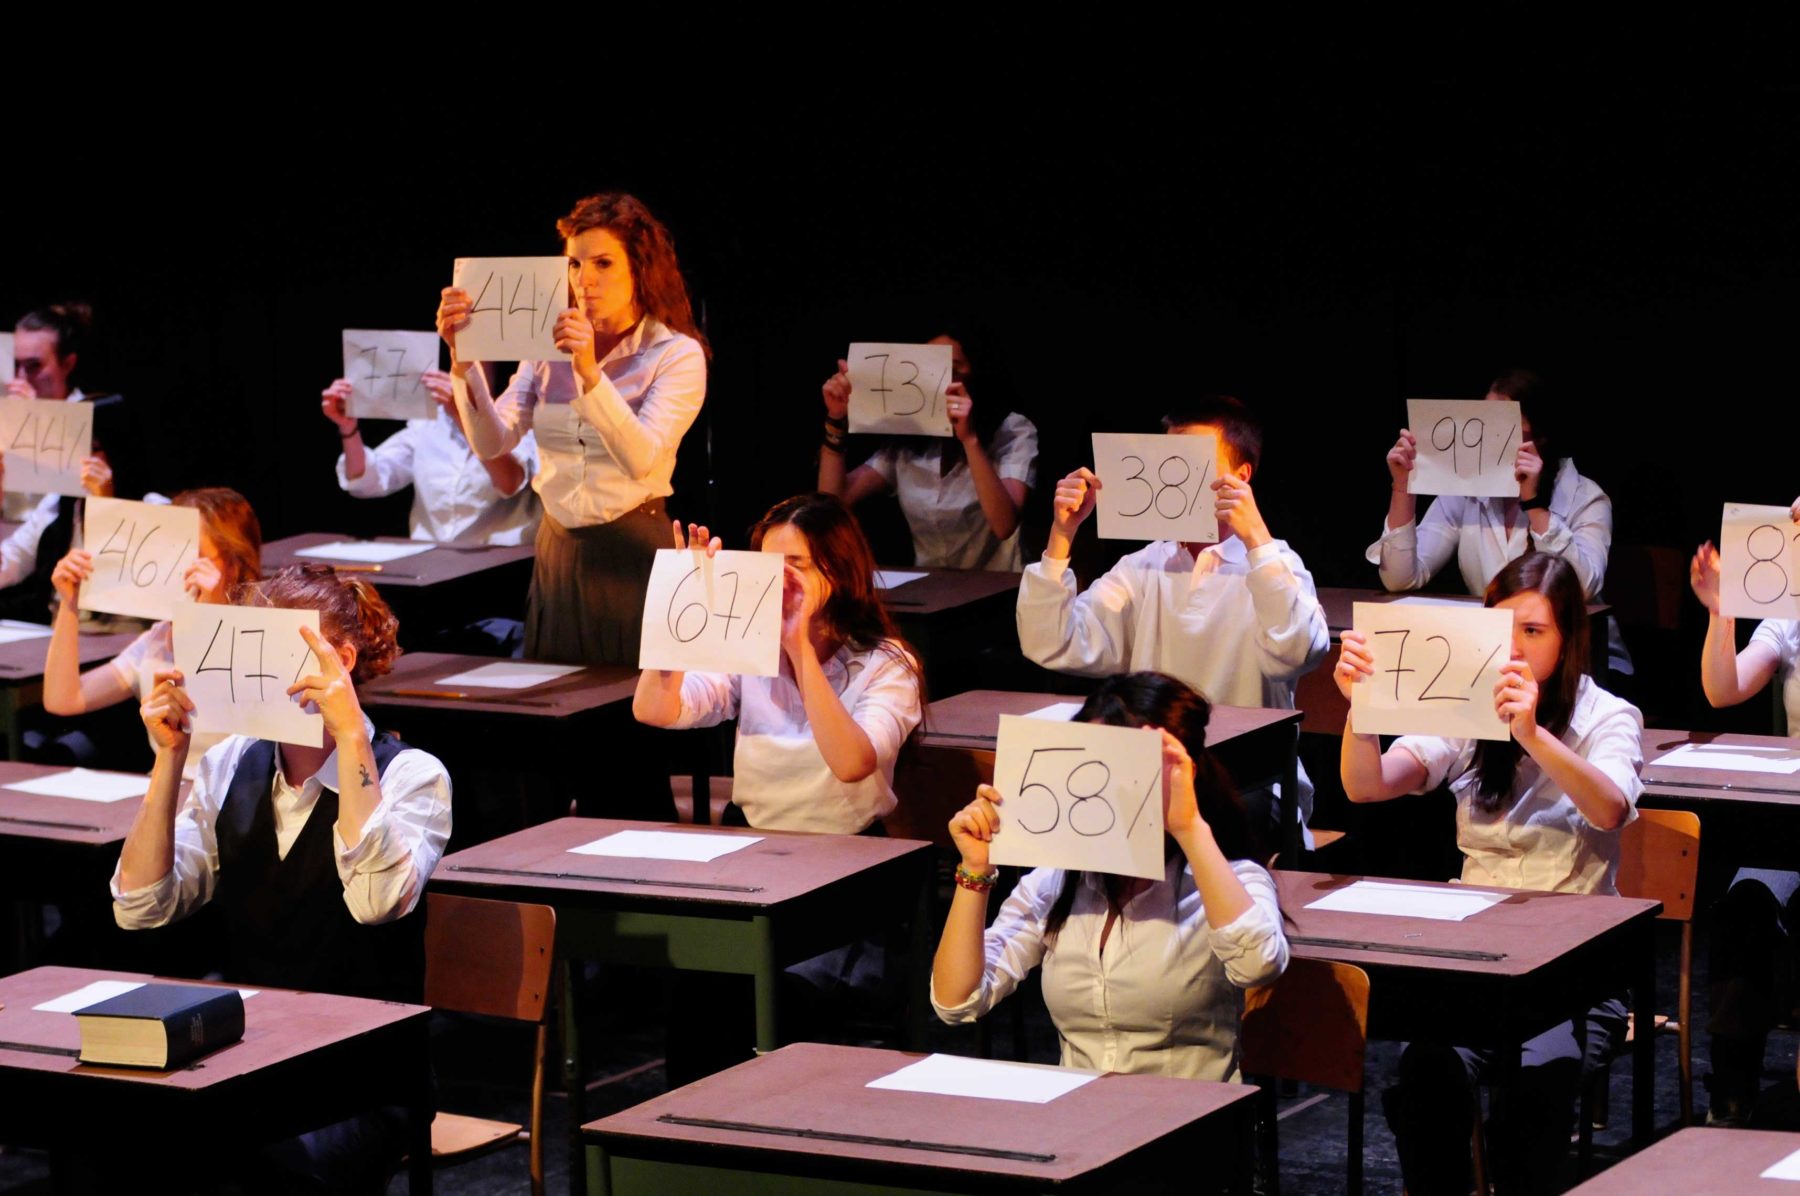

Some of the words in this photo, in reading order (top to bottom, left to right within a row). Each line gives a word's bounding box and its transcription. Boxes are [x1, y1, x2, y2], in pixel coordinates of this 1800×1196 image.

[471, 271, 561, 340] 44%
[865, 354, 948, 418] 73%
[1432, 416, 1517, 475] 99%
[1118, 455, 1210, 519] 38%
[99, 519, 191, 588] 46%
[1744, 525, 1800, 604] 8
[667, 567, 776, 643] 67%
[196, 619, 312, 704] 47%
[1374, 629, 1502, 701] 72%
[1018, 747, 1161, 837] 58%
